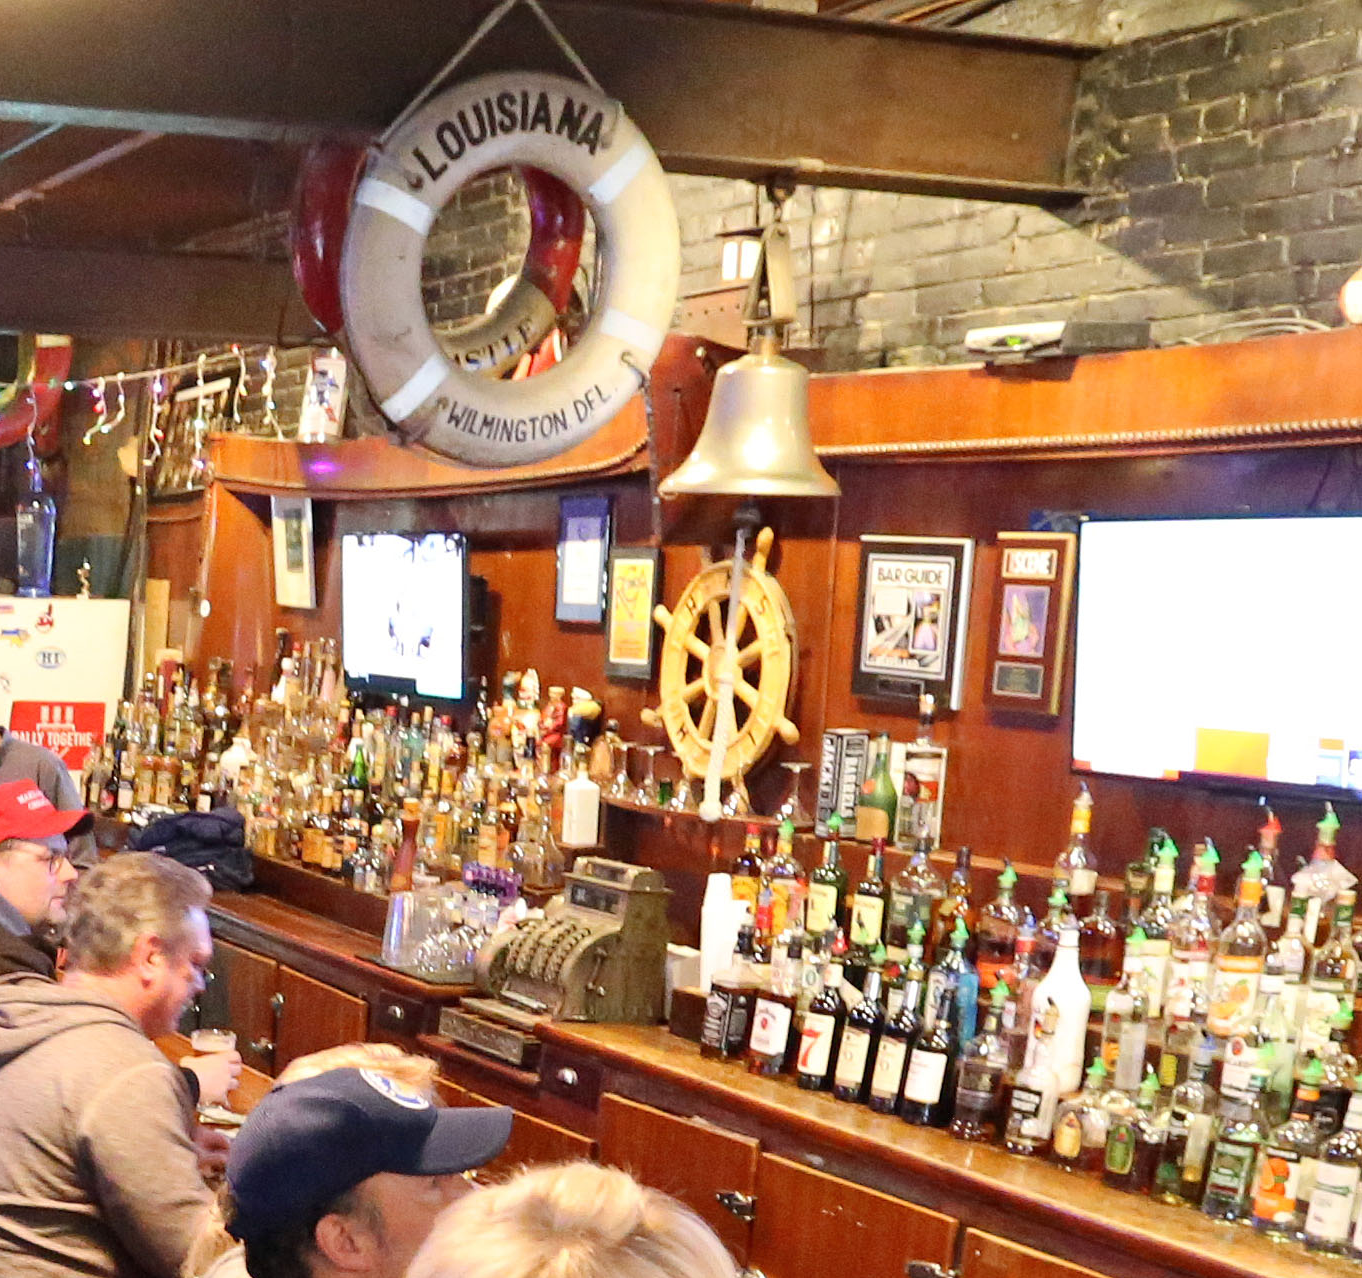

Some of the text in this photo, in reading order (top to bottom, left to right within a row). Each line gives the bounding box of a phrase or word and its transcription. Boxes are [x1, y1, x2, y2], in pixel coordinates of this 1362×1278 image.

[412, 90, 606, 182] LOUISIANA
[446, 405, 568, 443] WILMINGTON
[877, 566, 943, 585] BAR GUIDE
[47, 732, 101, 747] TOGETHE
[798, 1028, 821, 1068] 7
